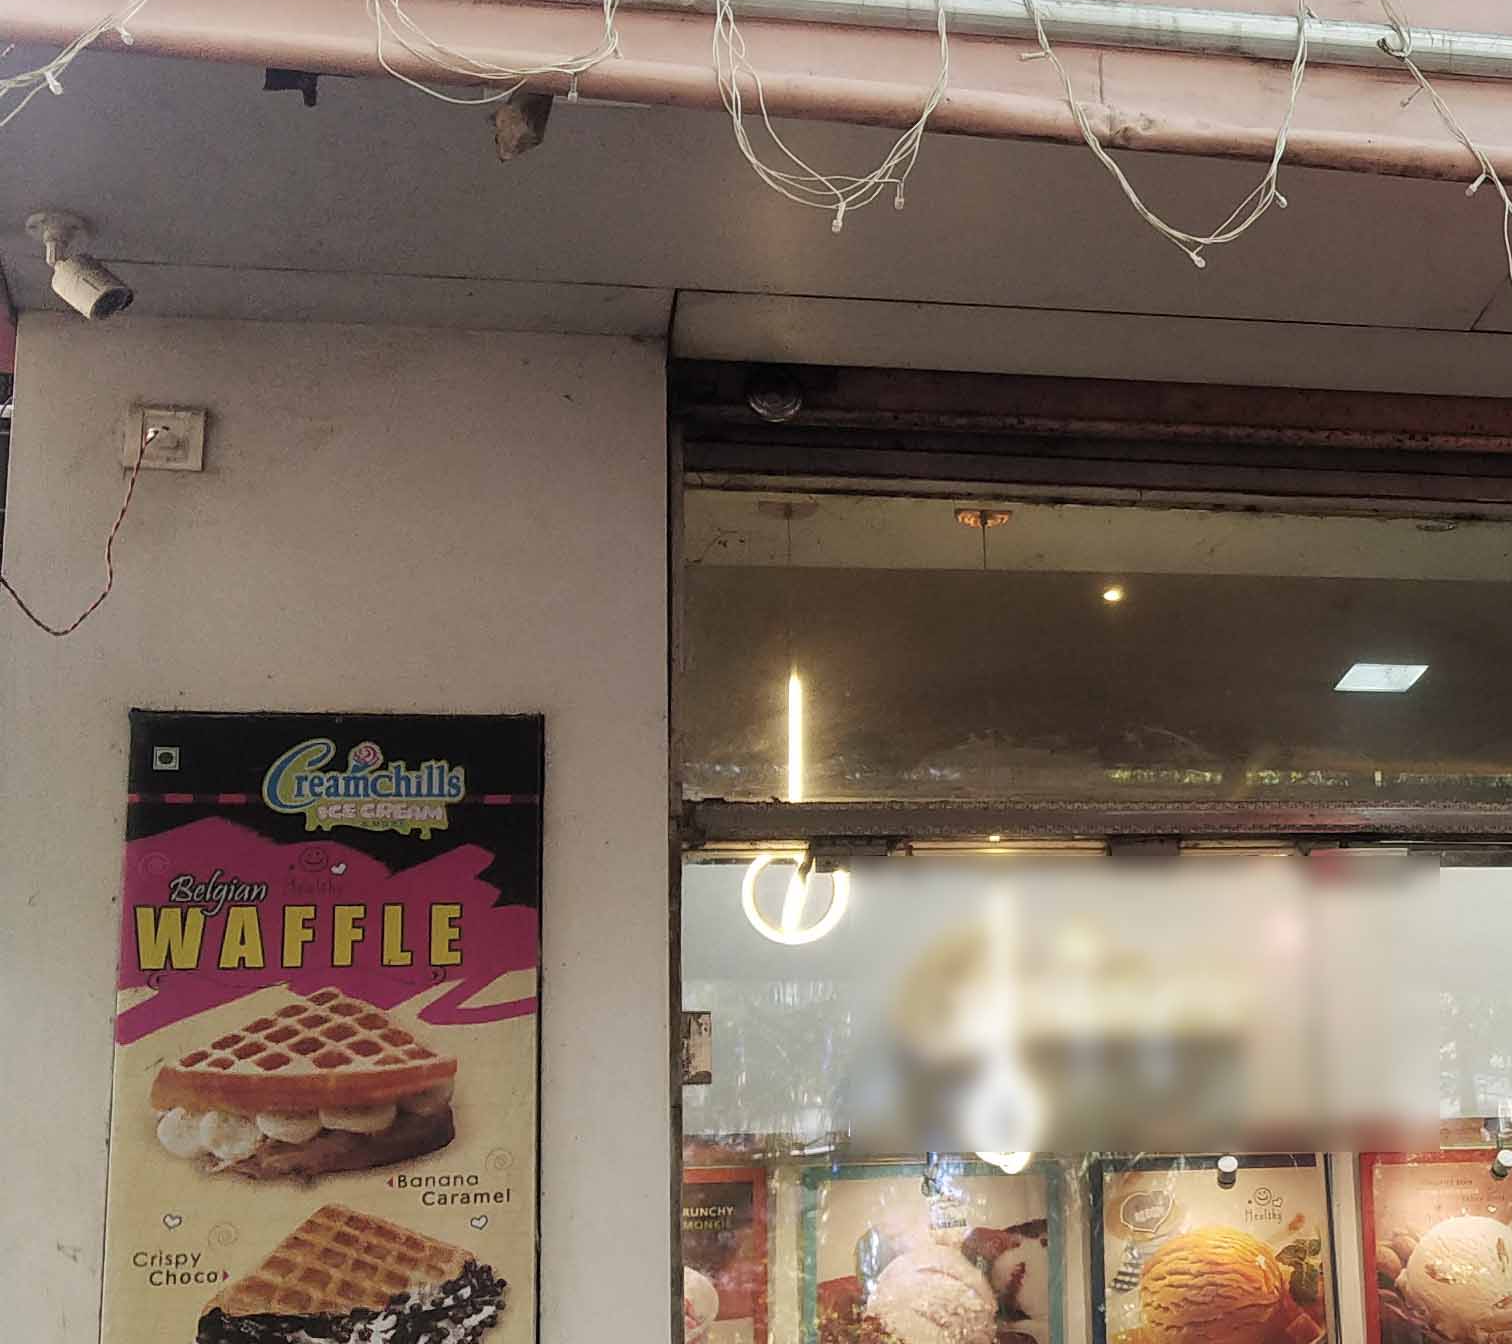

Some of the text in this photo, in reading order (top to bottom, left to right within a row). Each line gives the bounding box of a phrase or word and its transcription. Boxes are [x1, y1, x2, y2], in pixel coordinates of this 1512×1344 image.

[266, 741, 462, 809] Creamchills
[317, 803, 444, 821] ICE CREAM
[169, 874, 268, 916] Belgian
[134, 904, 464, 972] WAFFLE
[398, 1174, 480, 1189] Banana
[422, 1189, 512, 1207] Caramel
[132, 1251, 202, 1272] Crispy
[149, 1268, 219, 1287] Choco
